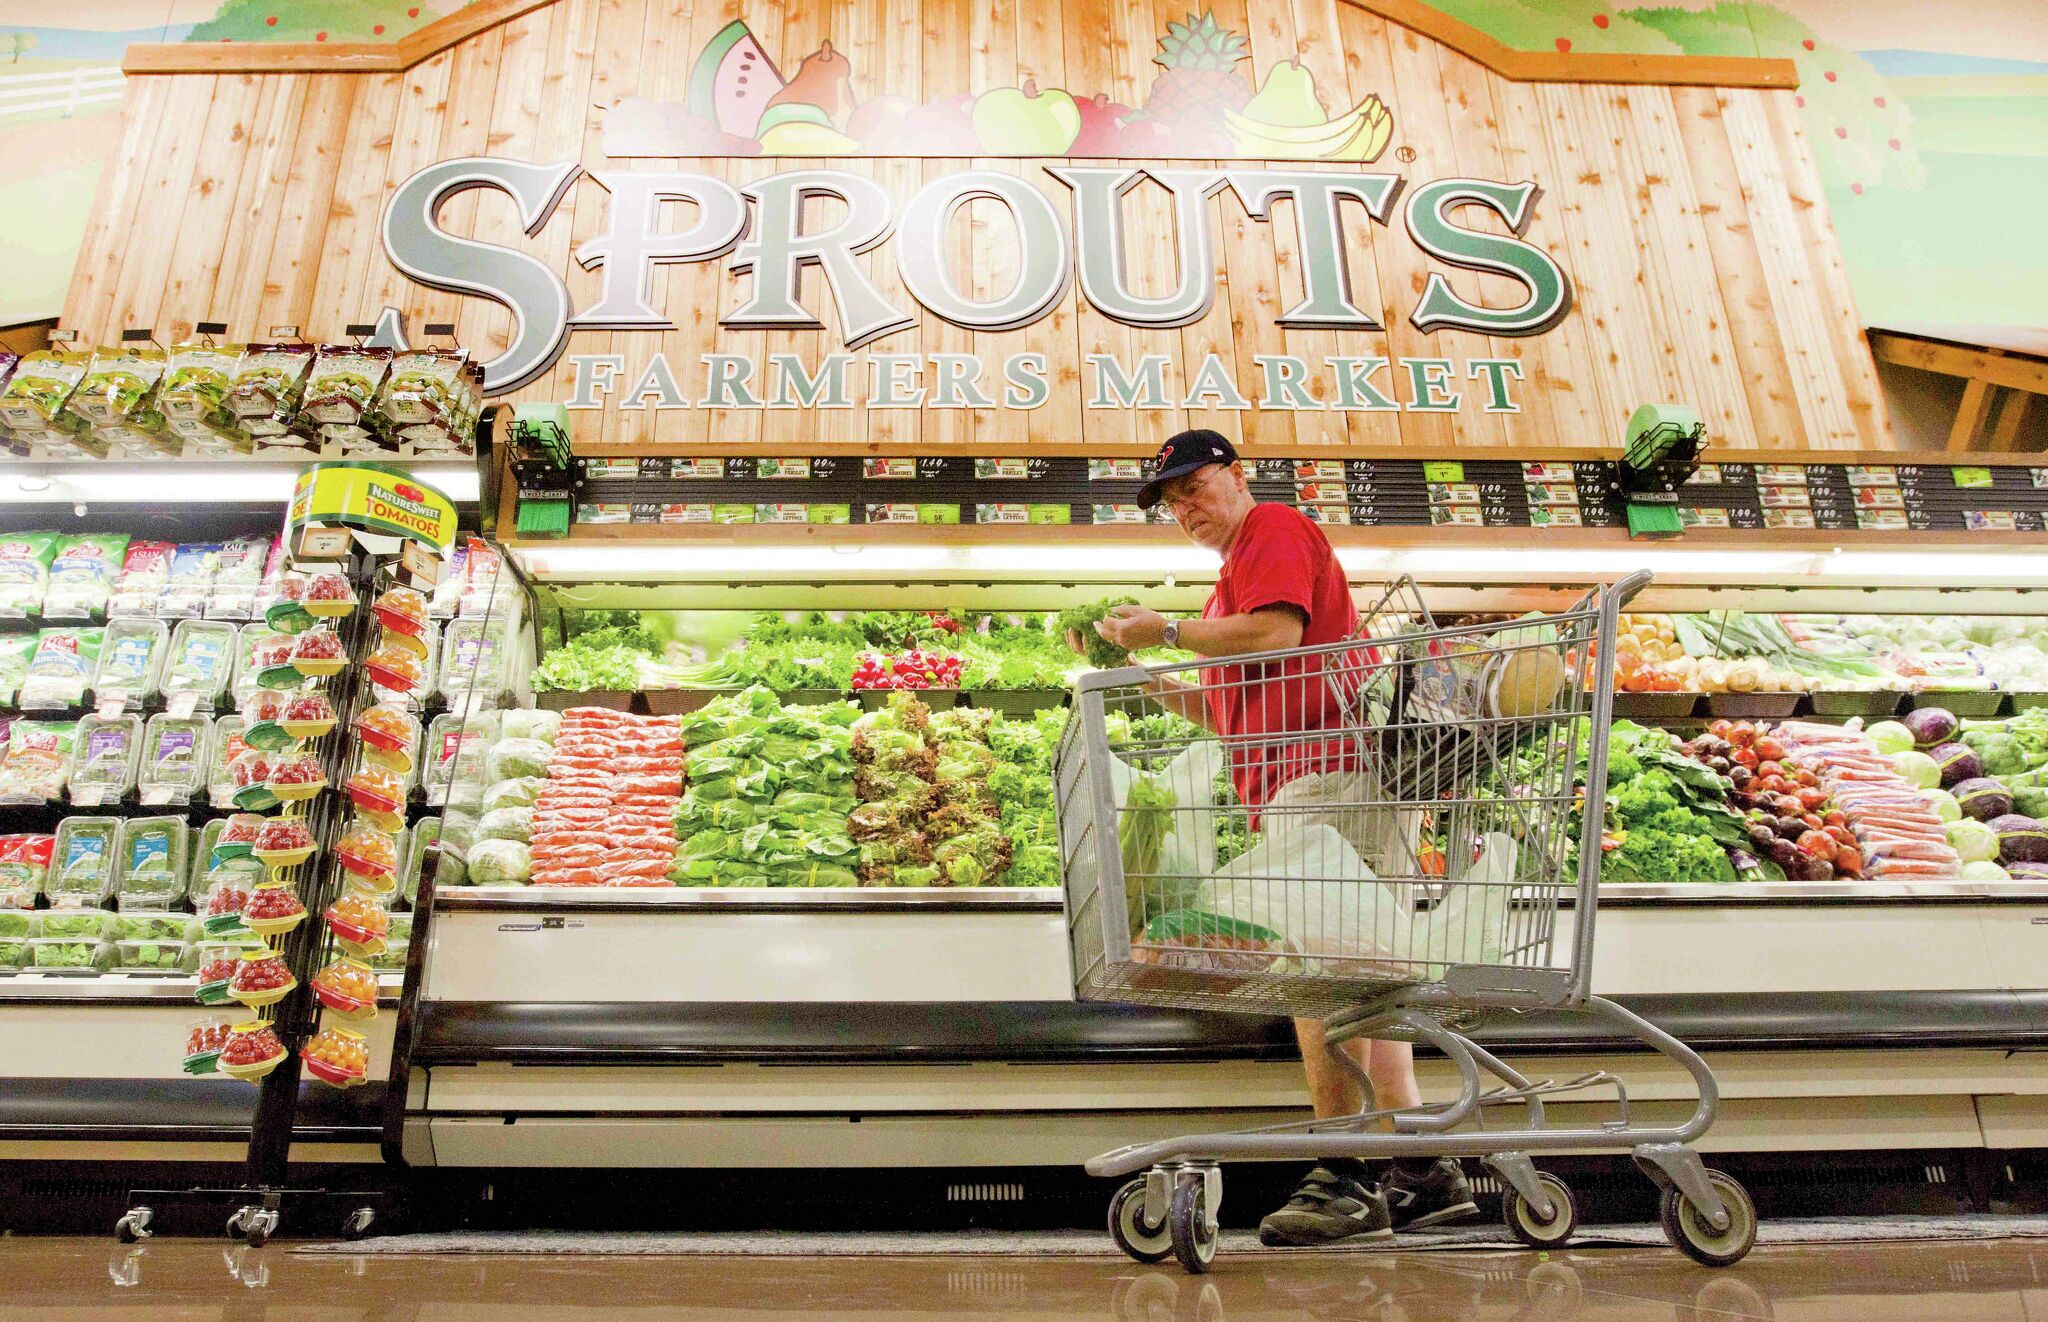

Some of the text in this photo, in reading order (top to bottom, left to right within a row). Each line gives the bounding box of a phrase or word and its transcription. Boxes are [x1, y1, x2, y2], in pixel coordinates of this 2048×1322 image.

[363, 156, 1573, 399] SPROUTS
[563, 353, 1525, 415] FARMERS MARKET
[365, 497, 441, 539] TOMATOES
[132, 550, 158, 559] ASIAN
[223, 542, 244, 552] KALE
